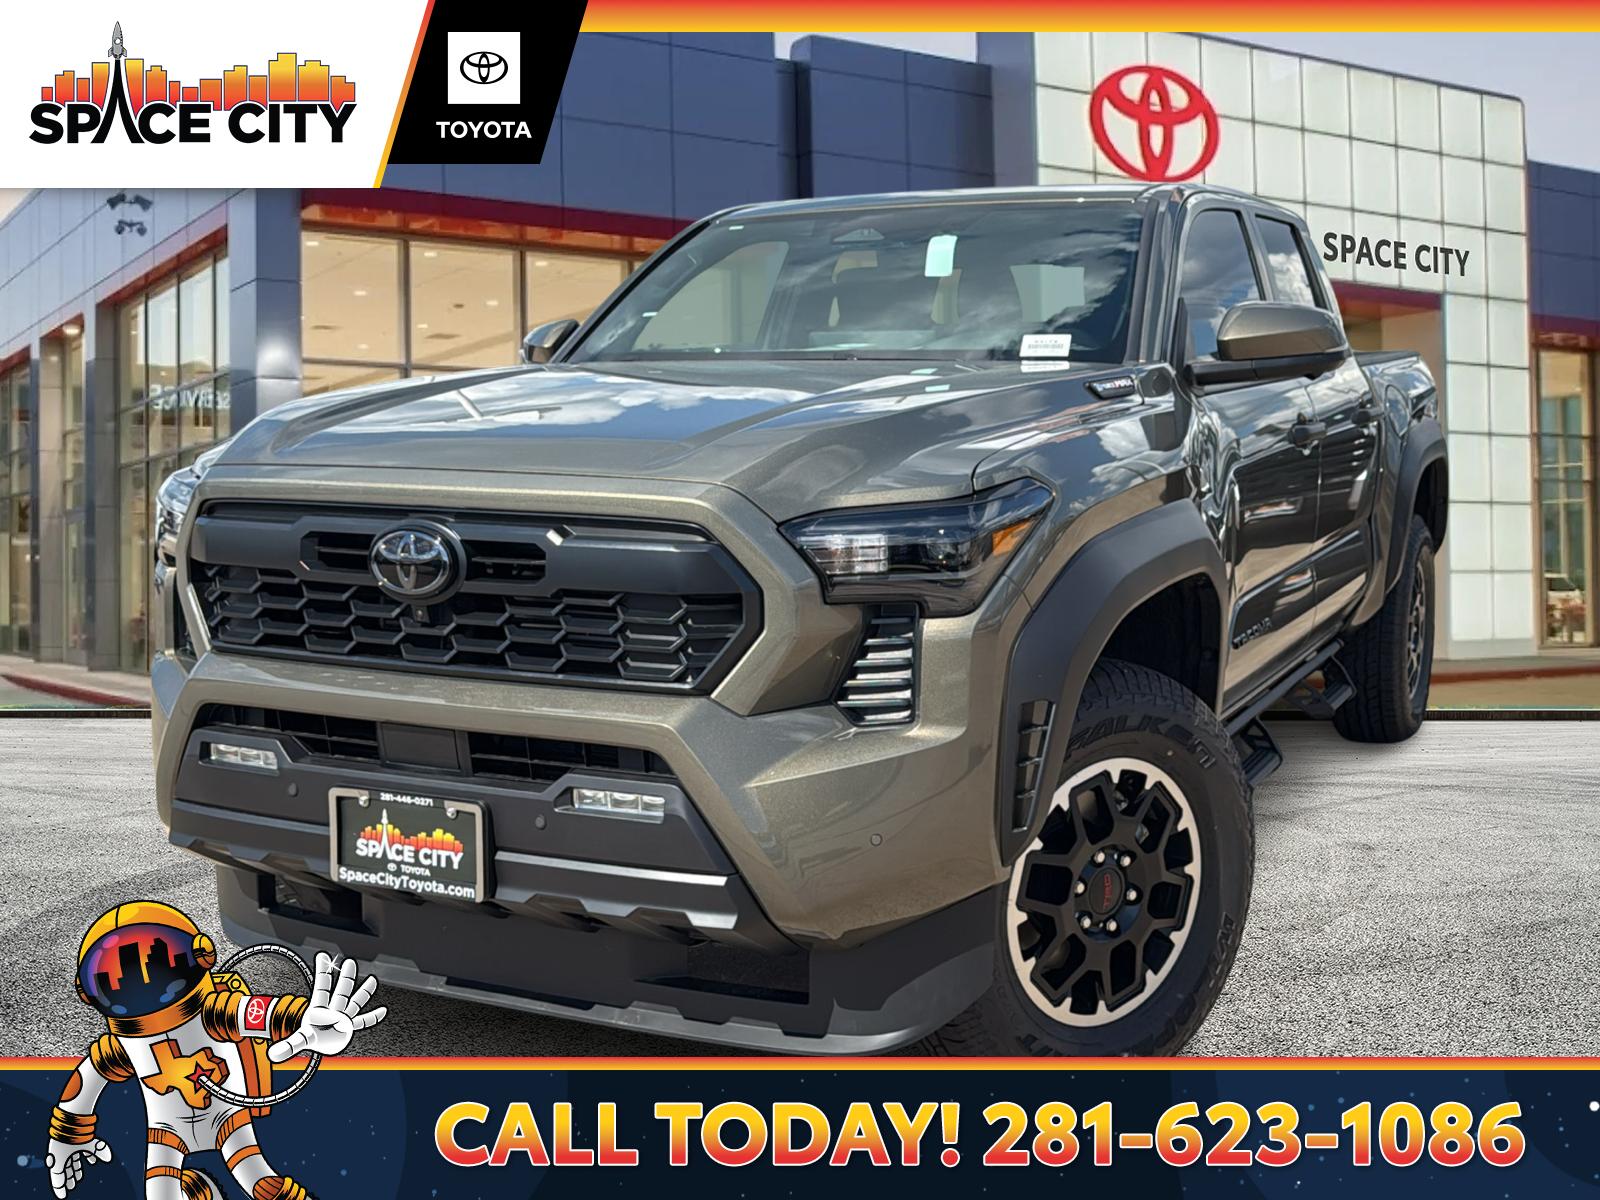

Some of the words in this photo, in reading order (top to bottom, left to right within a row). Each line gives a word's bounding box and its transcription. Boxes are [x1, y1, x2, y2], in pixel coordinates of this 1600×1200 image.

[1323, 232, 1407, 270] SPACE
[1414, 244, 1470, 277] CITY
[355, 837, 415, 862] SPACE
[418, 847, 463, 870] CITY
[339, 866, 475, 899] SpaceCityToyota.com
[401, 864, 431, 877] TOYOTA
